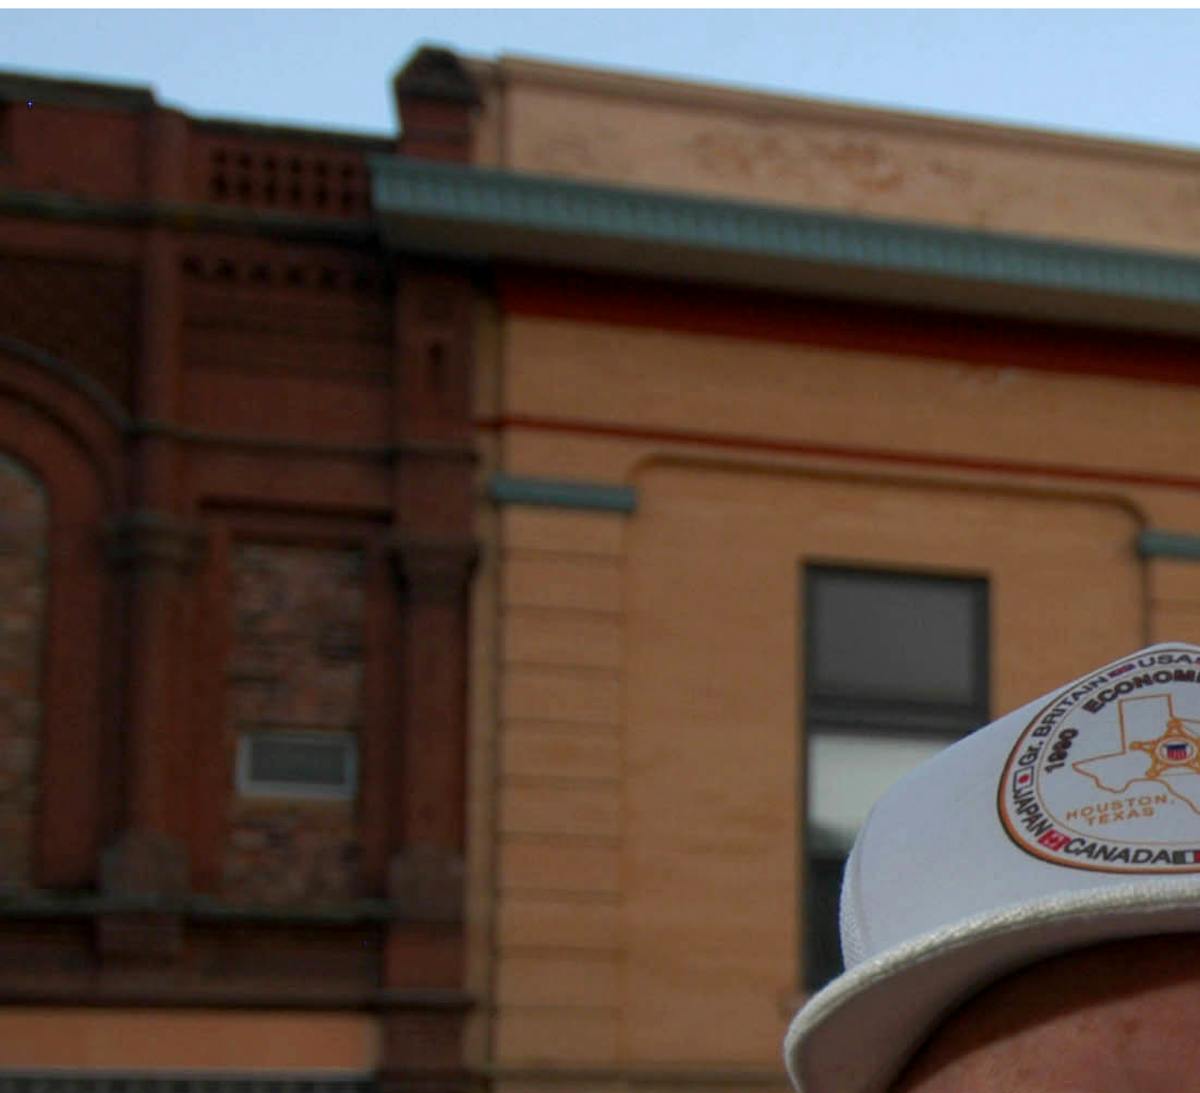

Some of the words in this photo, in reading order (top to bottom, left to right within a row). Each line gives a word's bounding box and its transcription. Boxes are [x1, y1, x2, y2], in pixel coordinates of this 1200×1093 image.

[1138, 653, 1193, 669] USA
[1032, 675, 1108, 739] BRITAIN
[1012, 787, 1052, 838] JAPAN
[1086, 807, 1155, 826] TEXAS
[1063, 836, 1173, 865] CANADA
